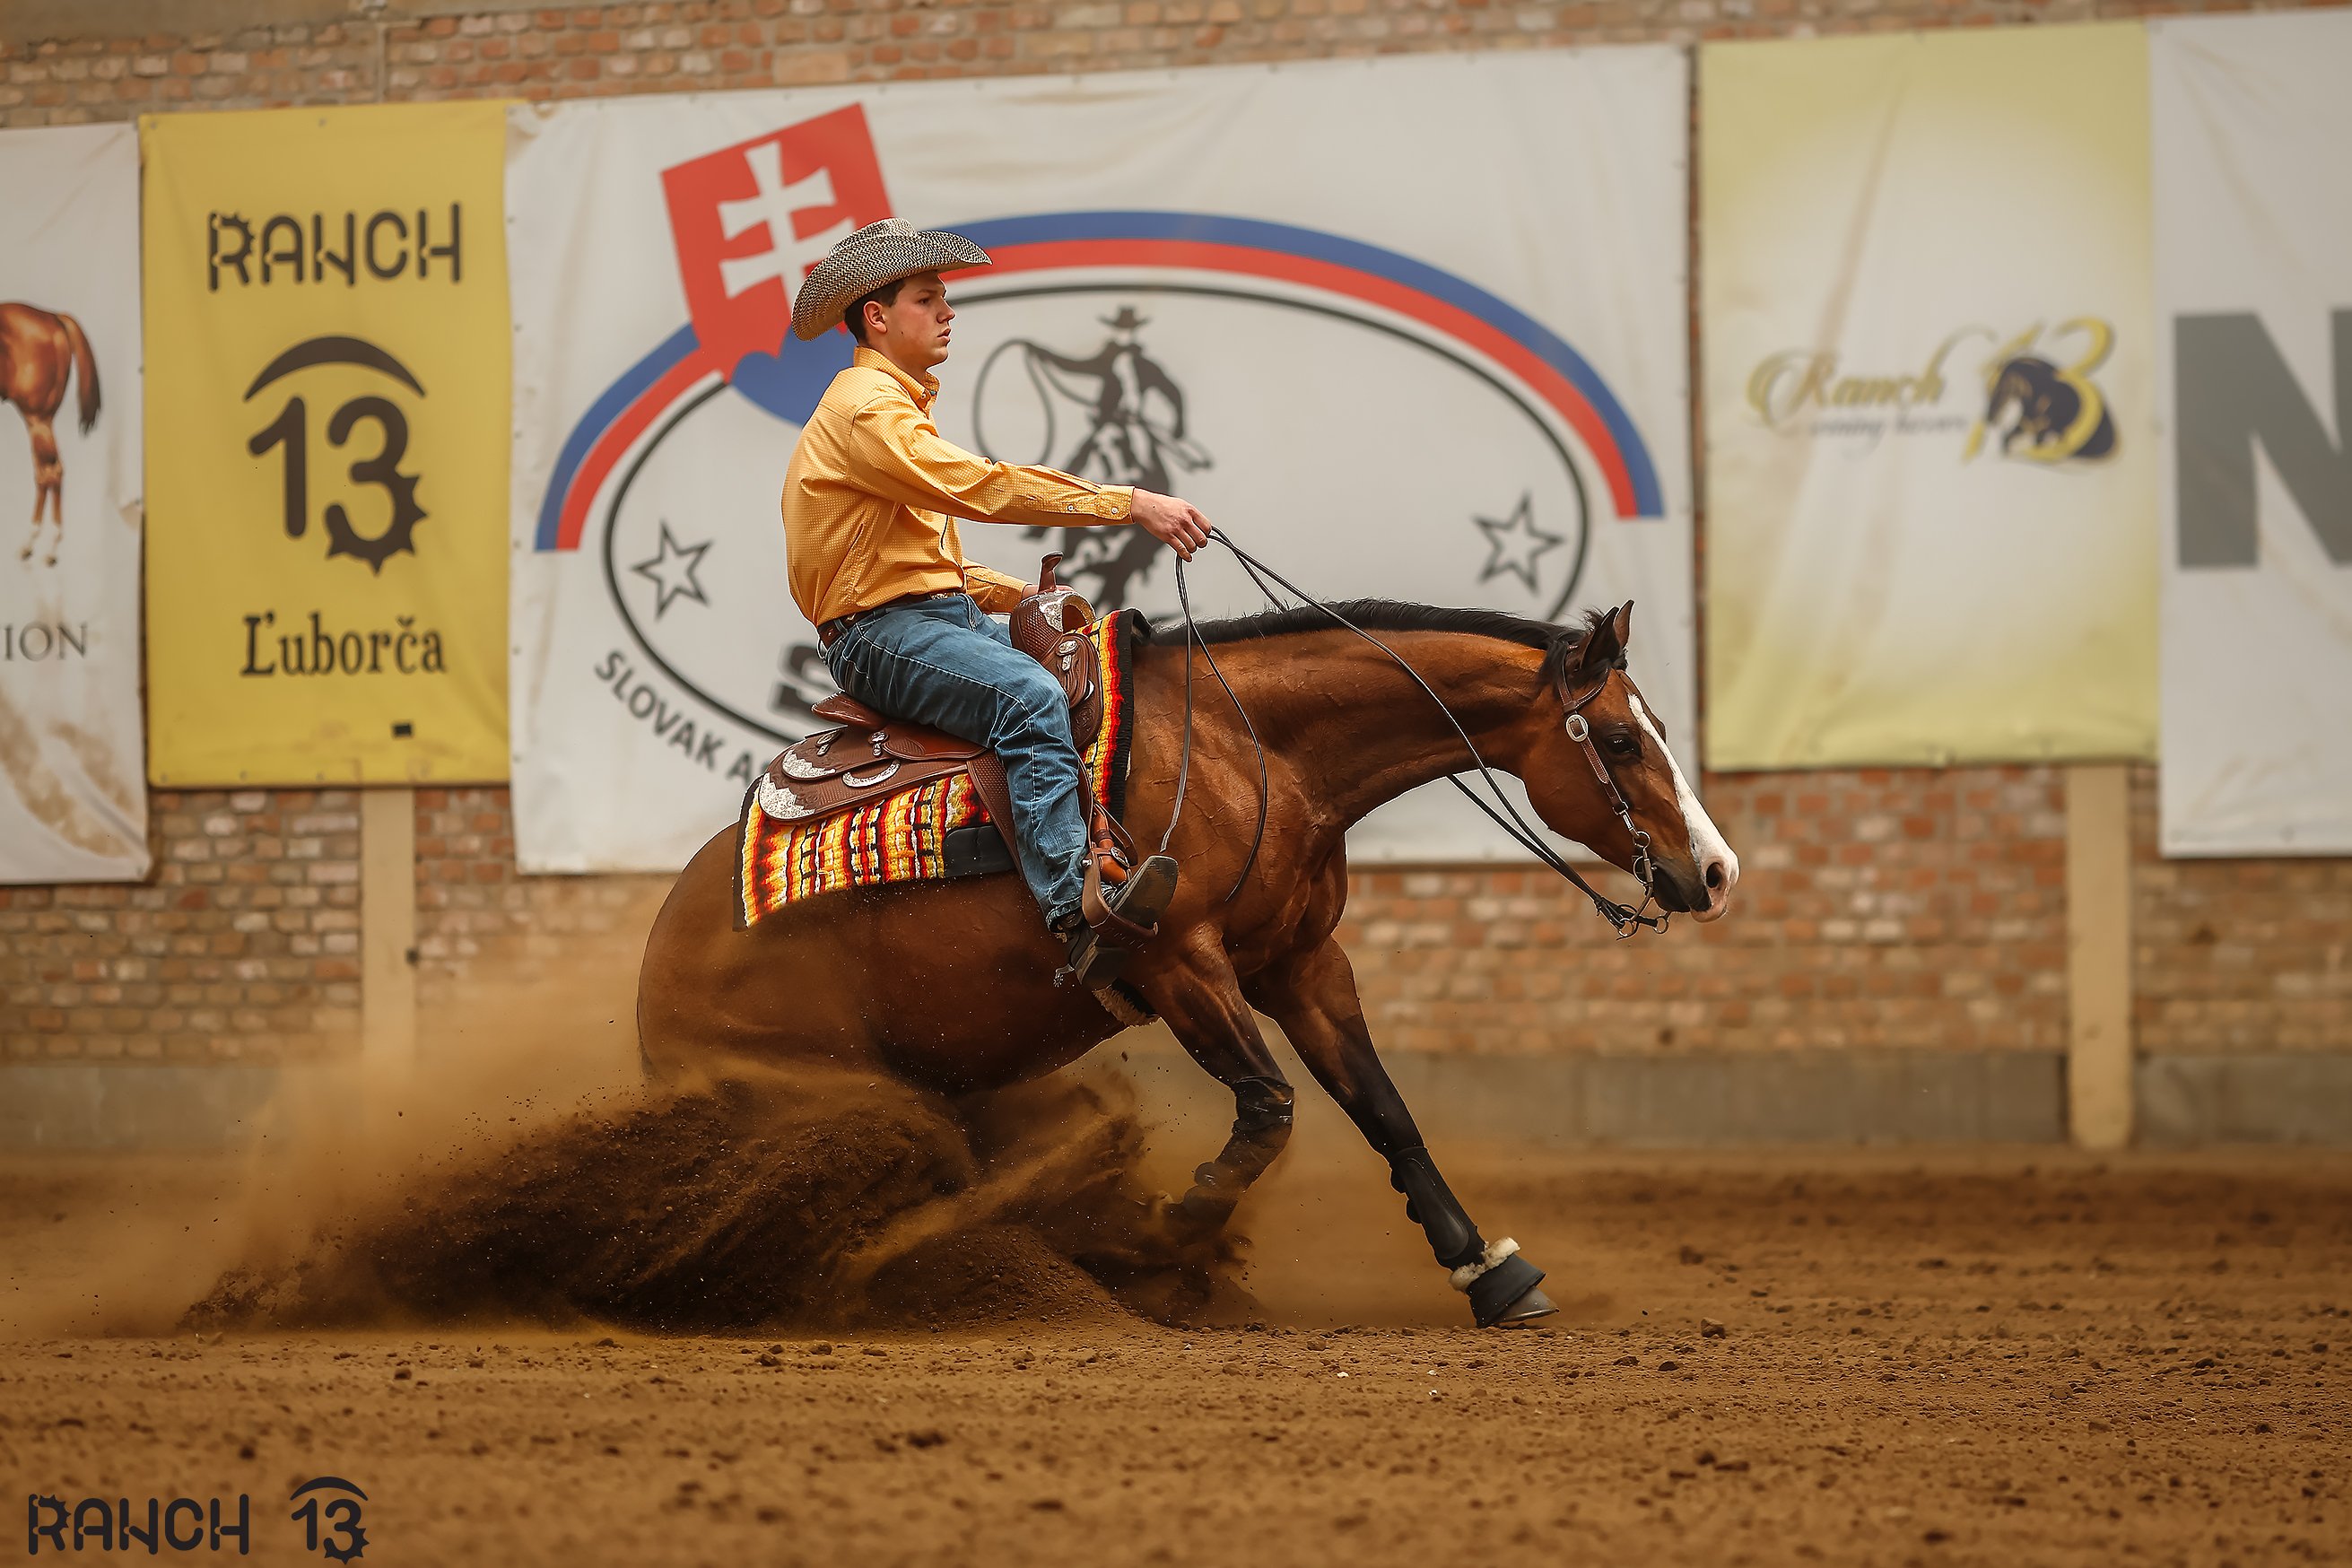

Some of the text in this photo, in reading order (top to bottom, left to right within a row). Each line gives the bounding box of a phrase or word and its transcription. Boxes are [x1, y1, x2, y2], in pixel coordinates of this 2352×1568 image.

[207, 202, 461, 291] RANCH
[247, 395, 429, 577] 13
[240, 611, 447, 677] Ľuborča
[593, 649, 725, 771] SLOVAK
